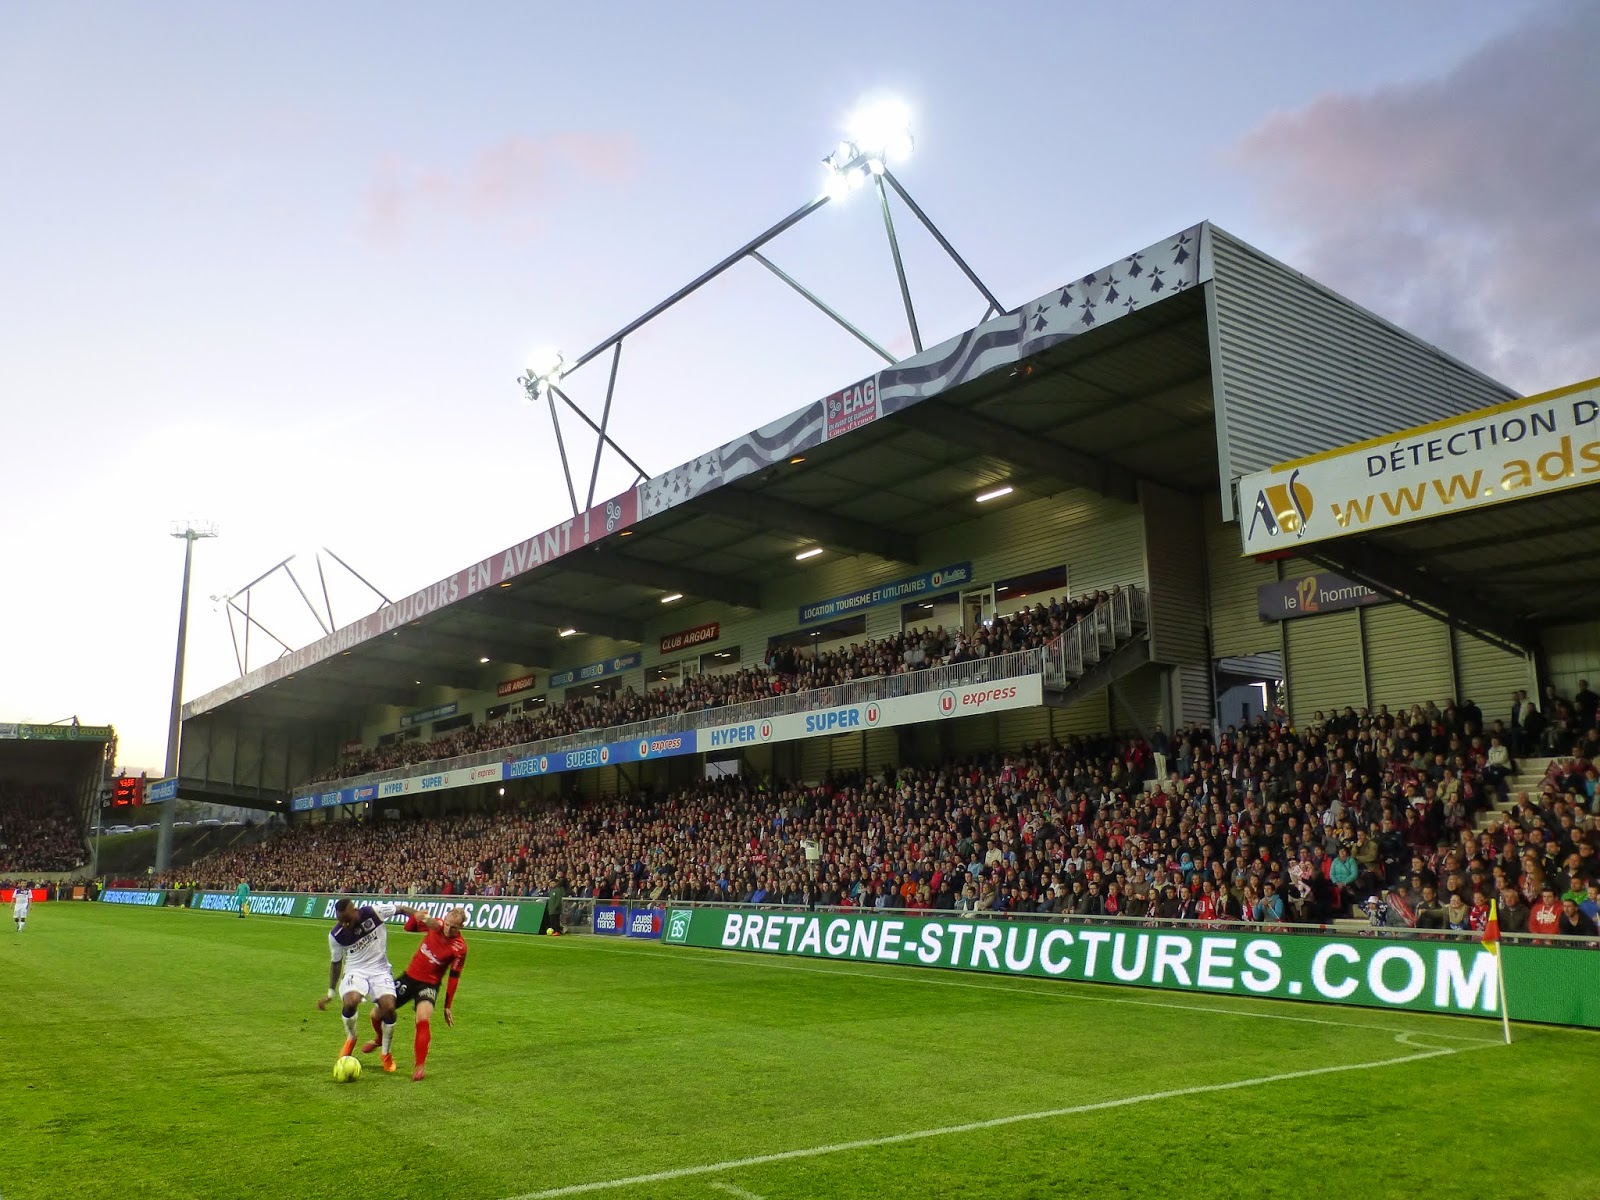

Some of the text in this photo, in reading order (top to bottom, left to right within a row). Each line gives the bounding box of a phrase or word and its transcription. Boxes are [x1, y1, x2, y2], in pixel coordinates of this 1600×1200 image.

[843, 380, 875, 416] EAG
[1367, 409, 1557, 478] DÉTECTION
[280, 650, 305, 678] TOUS
[379, 574, 459, 632] TOUJOURS
[468, 559, 491, 594] EN
[501, 520, 573, 579] AVANT
[804, 603, 834, 619] LOCATION
[836, 593, 871, 611] TOURISME
[872, 591, 881, 602] ET
[883, 579, 926, 599] UTILITAIRES
[1284, 596, 1297, 610] le
[1296, 576, 1319, 612] 12
[662, 627, 716, 650] CLUB ARGOAT
[499, 677, 534, 693] CLUB ARGOAT
[711, 724, 756, 746] HYPER
[806, 708, 860, 732] SUPER
[962, 686, 1017, 707] express
[510, 759, 539, 776] HYPER
[566, 749, 599, 768] SUPER
[652, 738, 682, 753] express
[384, 783, 403, 795] HYPER
[422, 776, 442, 789] SUPER
[477, 768, 496, 779] express
[597, 918, 615, 929] france
[599, 910, 616, 920] ouest
[632, 921, 652, 933] france
[635, 913, 652, 924] ouest
[671, 920, 685, 938] BS
[721, 913, 1499, 1013] BRETAGNE-STRUCTURES.COM
